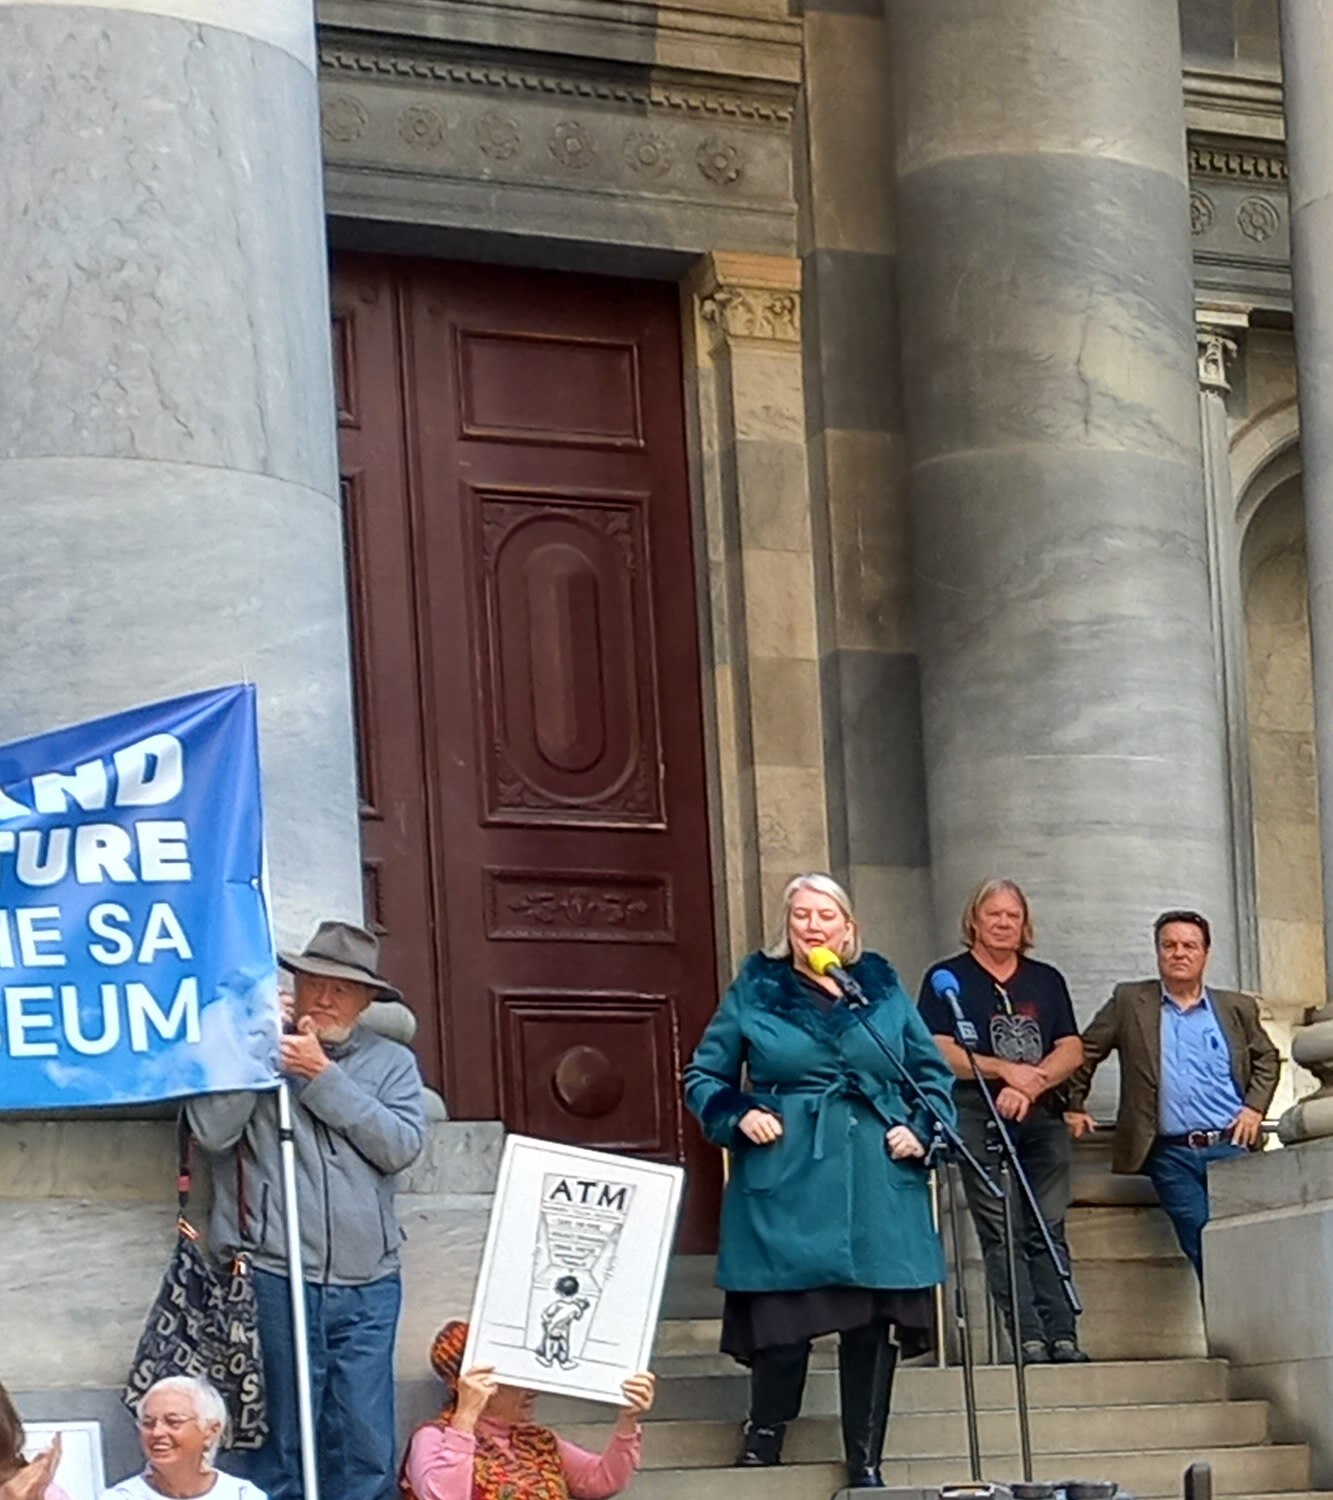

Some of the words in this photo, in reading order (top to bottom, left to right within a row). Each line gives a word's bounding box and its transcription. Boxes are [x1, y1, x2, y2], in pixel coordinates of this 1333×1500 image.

[88, 902, 194, 966] SA
[0, 976, 201, 1058] EUM
[549, 1179, 627, 1210] ATM
